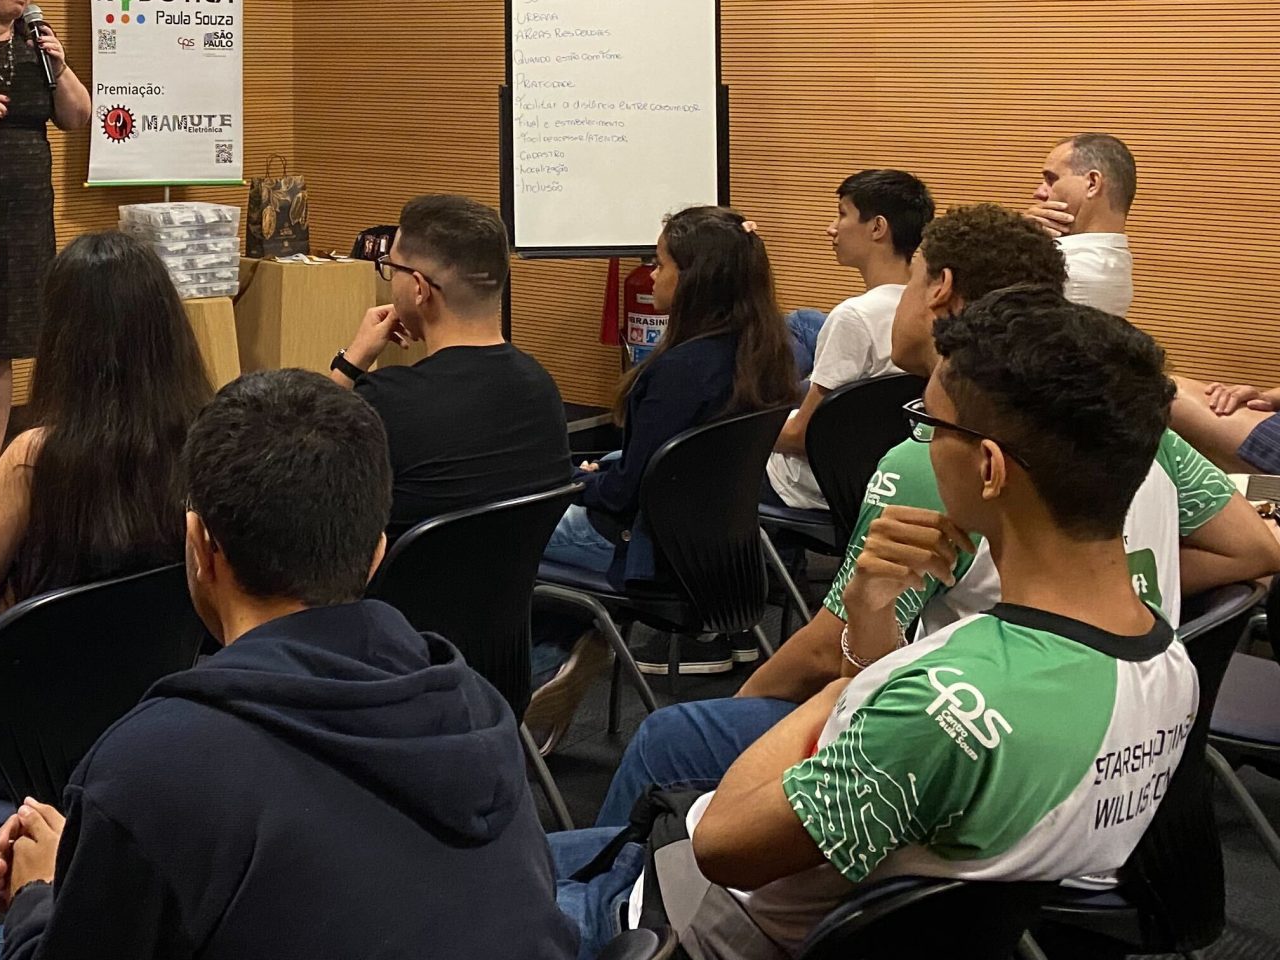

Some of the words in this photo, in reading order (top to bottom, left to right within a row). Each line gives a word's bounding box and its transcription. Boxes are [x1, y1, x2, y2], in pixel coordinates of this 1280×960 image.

[156, 10, 191, 25] Paula
[195, 11, 234, 26] Souza
[213, 29, 234, 40] SÃO
[203, 40, 234, 48] PAULO
[96, 83, 166, 98] Premiação:
[141, 114, 233, 133] MAMUTE
